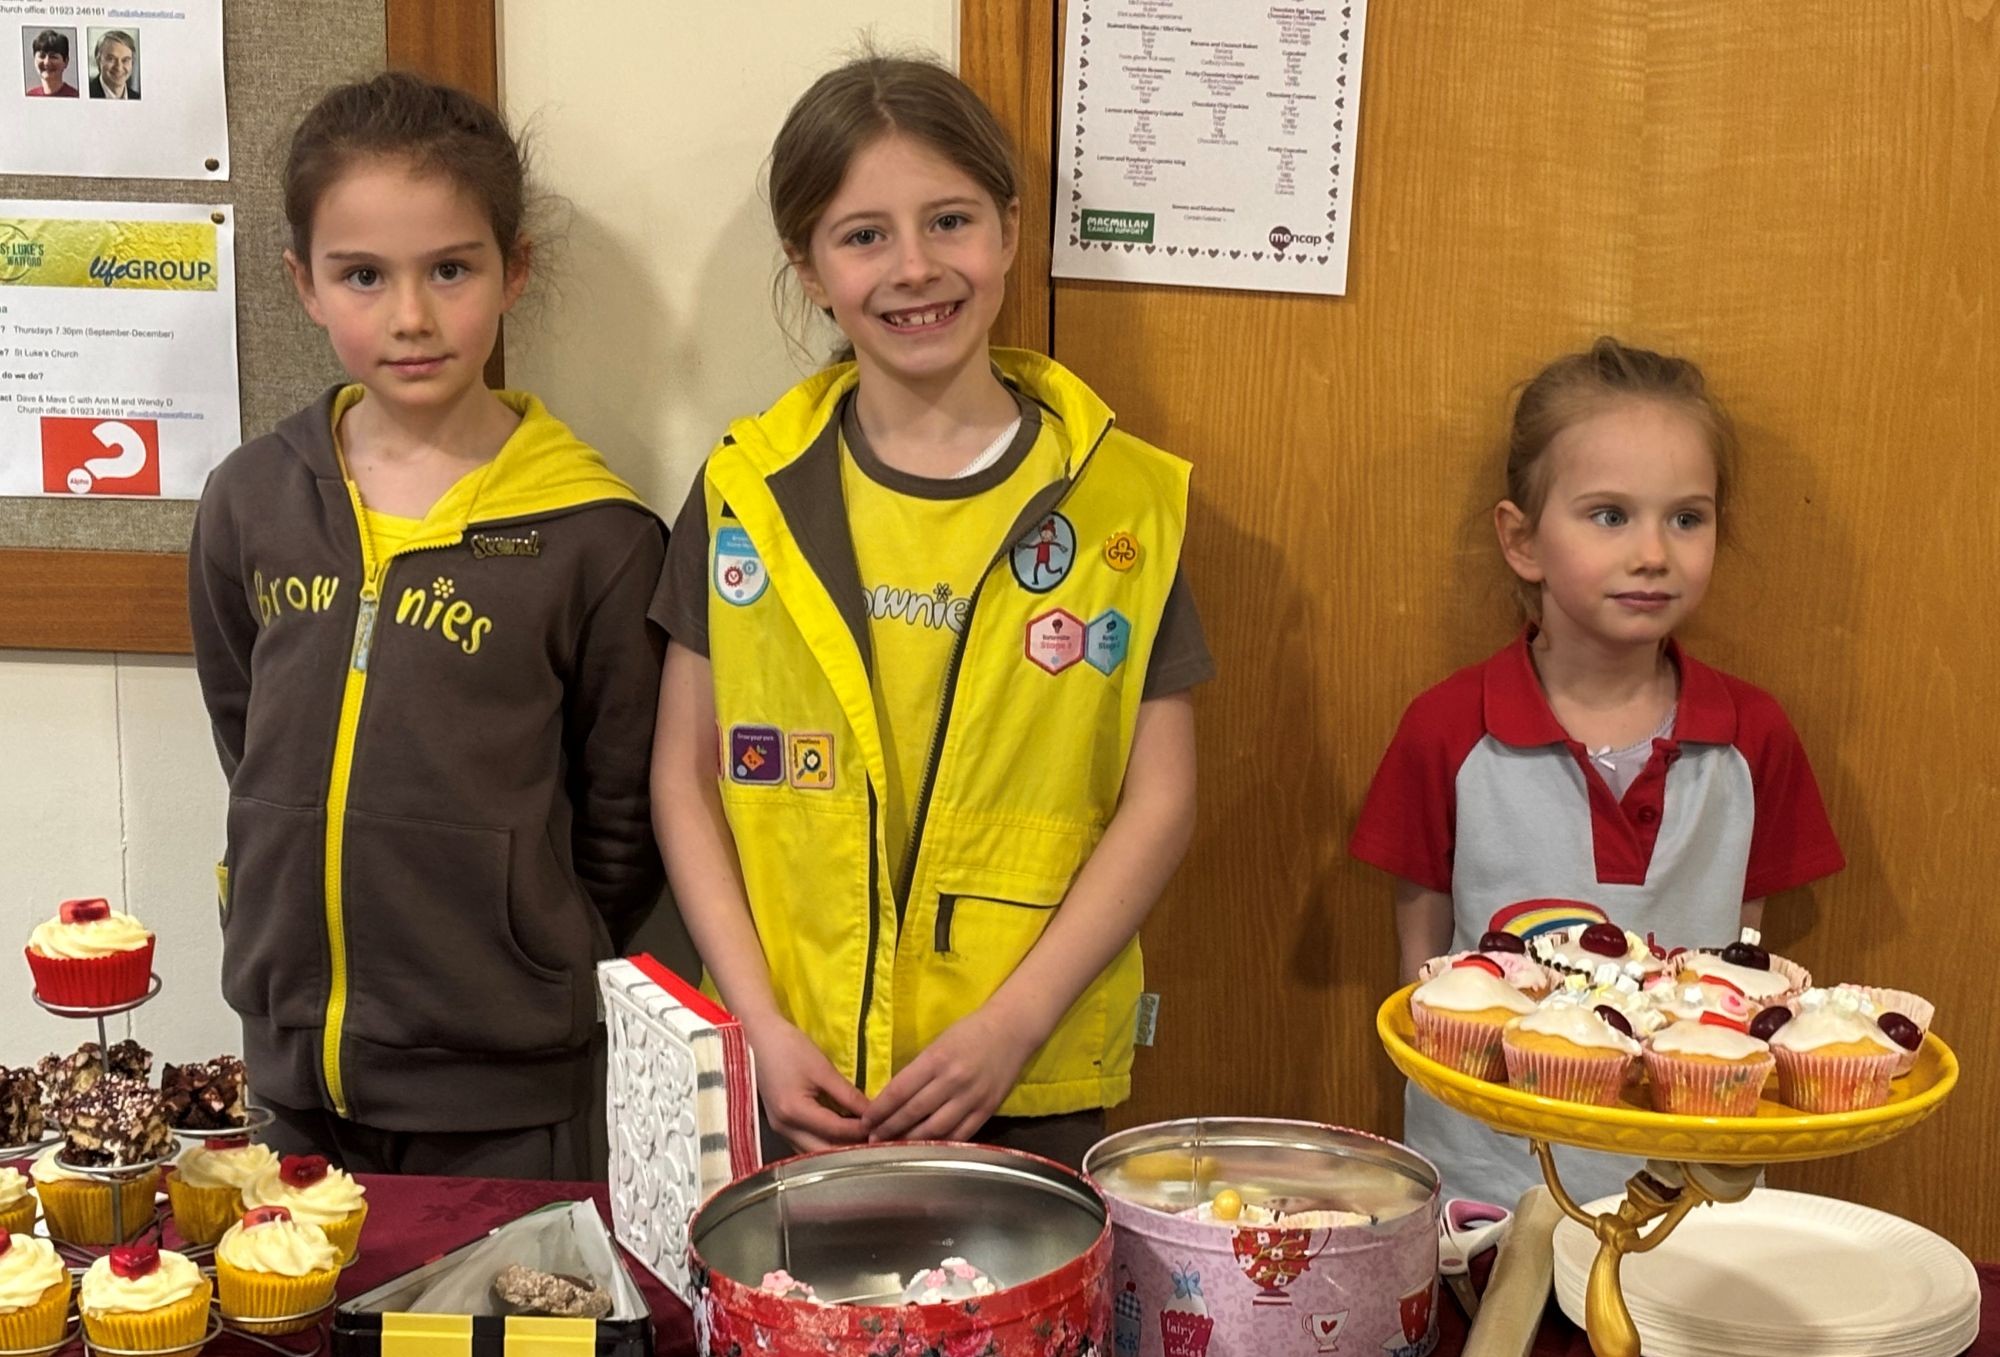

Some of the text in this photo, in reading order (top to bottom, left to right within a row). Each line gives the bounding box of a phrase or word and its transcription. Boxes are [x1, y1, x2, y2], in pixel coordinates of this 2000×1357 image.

[0, 6, 23, 15] hurch
[24, 7, 47, 16] office:
[49, 7, 74, 16] 01923
[1086, 217, 1149, 229] MACMILLAN
[1086, 226, 1146, 236] CANCER SUPPORT
[1270, 231, 1322, 246] mencap
[12, 244, 44, 257] LUKE'S
[7, 256, 42, 268] WATFORD
[14, 325, 53, 336] Thursdays
[24, 349, 50, 358] Luke's
[51, 350, 79, 359] Church
[2, 372, 13, 380] do
[28, 372, 44, 381] do?
[17, 394, 37, 402] Dave
[38, 394, 45, 403] &
[69, 395, 75, 404] C
[77, 396, 92, 404] with
[94, 396, 110, 405] Ann
[111, 397, 119, 405] M
[121, 397, 135, 405] and
[137, 398, 164, 408] Wendy
[166, 399, 173, 407] D
[17, 406, 44, 415] Church
[45, 407, 69, 415] office:
[70, 408, 95, 416] 01923
[860, 583, 973, 634] ownie
[1166, 1317, 1196, 1345] fairy
